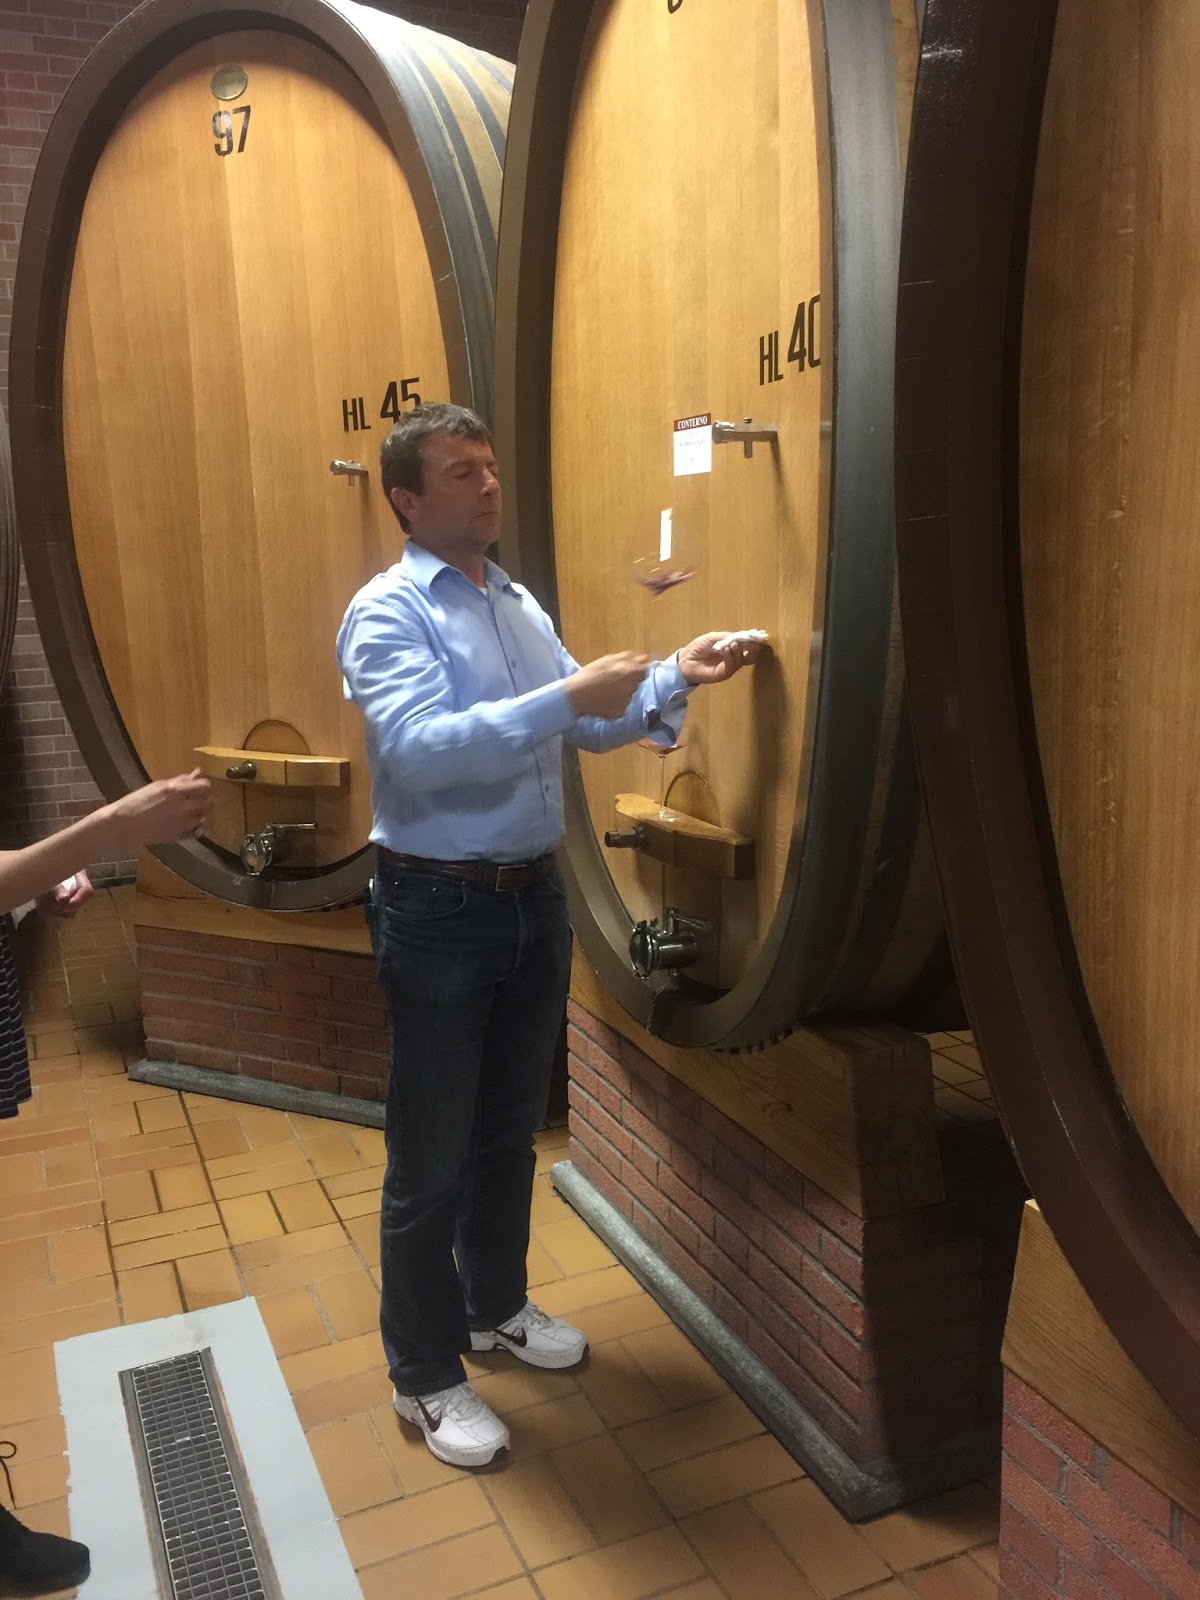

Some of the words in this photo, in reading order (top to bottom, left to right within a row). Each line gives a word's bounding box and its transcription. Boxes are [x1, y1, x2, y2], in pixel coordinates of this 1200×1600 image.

[212, 105, 251, 157] 97
[759, 330, 784, 386] HL
[342, 397, 371, 433] HL
[380, 377, 421, 424] 45
[677, 415, 708, 430] CONTERNO
